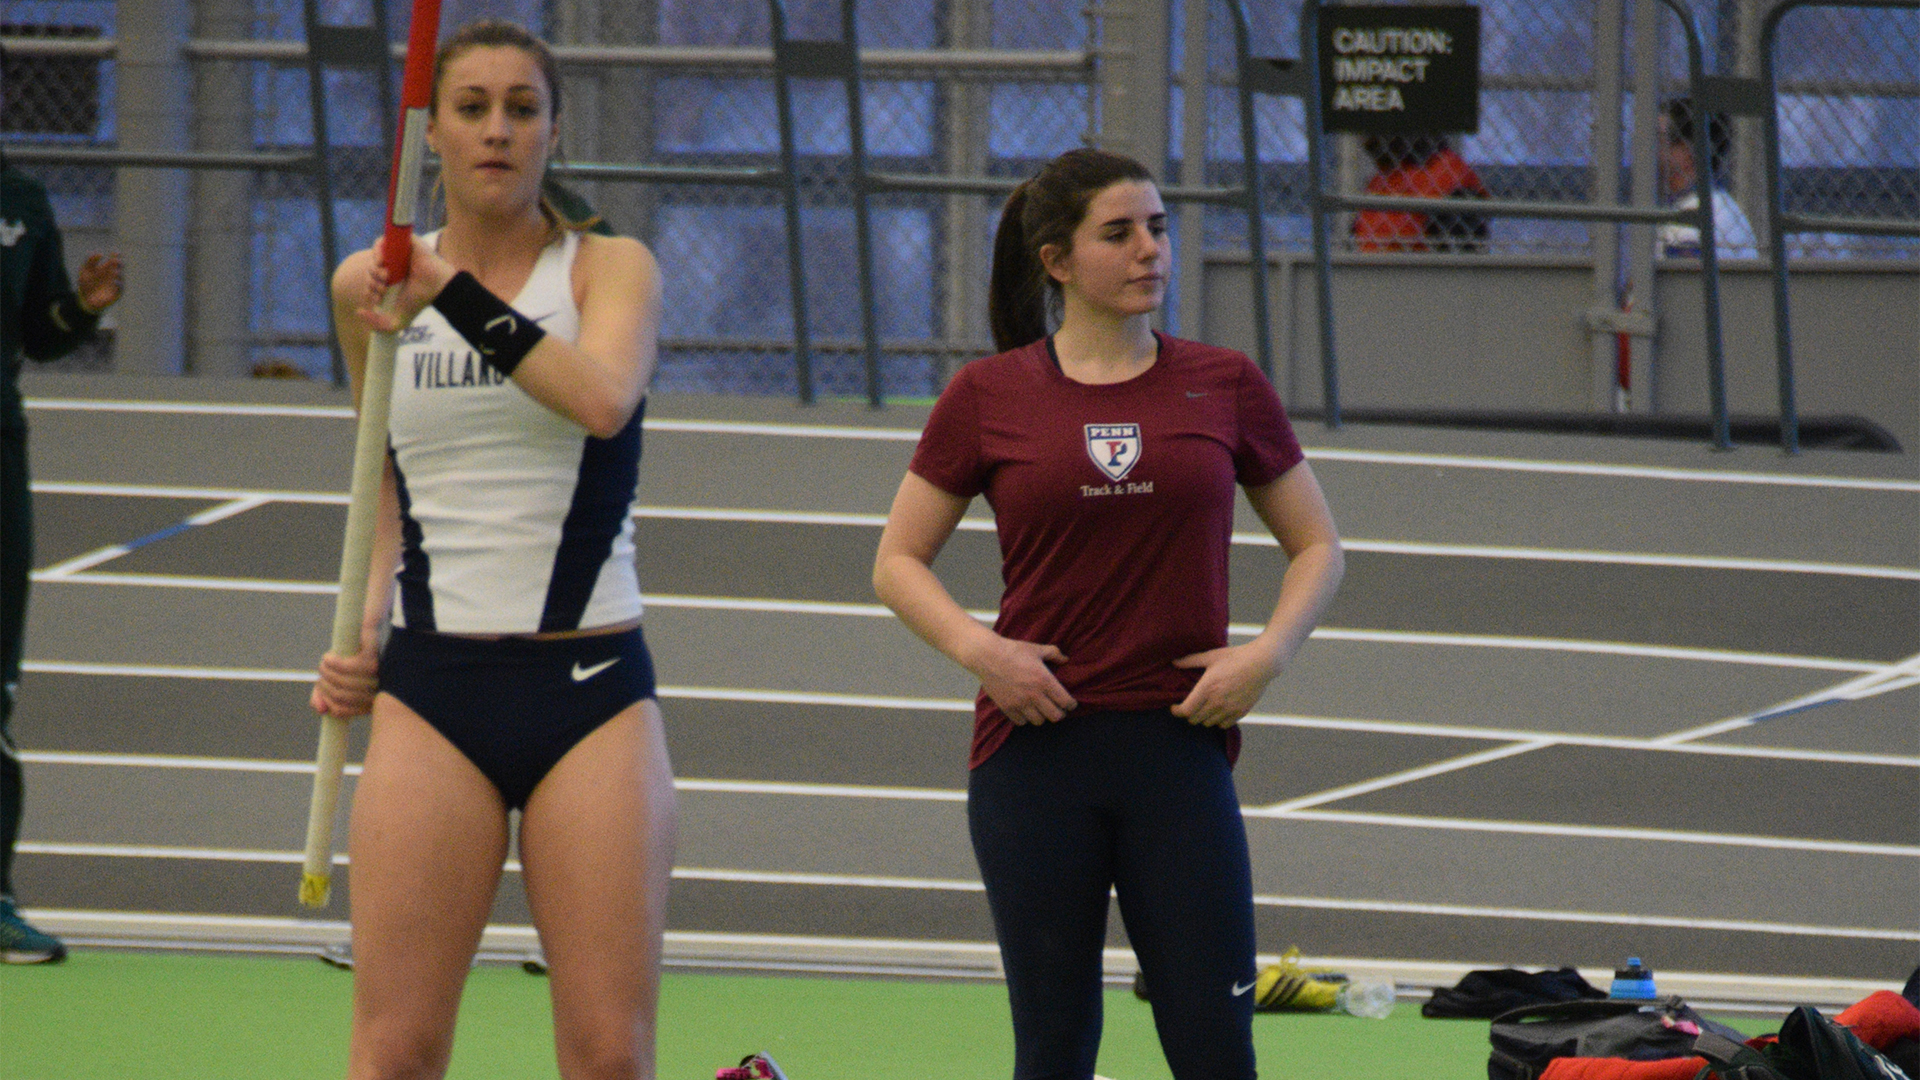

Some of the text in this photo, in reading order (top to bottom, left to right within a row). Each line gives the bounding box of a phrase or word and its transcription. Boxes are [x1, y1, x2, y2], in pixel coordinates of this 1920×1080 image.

[1332, 27, 1453, 54] CAUTION:
[1333, 57, 1430, 83] IMPACT
[1332, 85, 1405, 111] AREA
[1090, 427, 1135, 438] PENN
[1080, 481, 1154, 497] Track & Field
